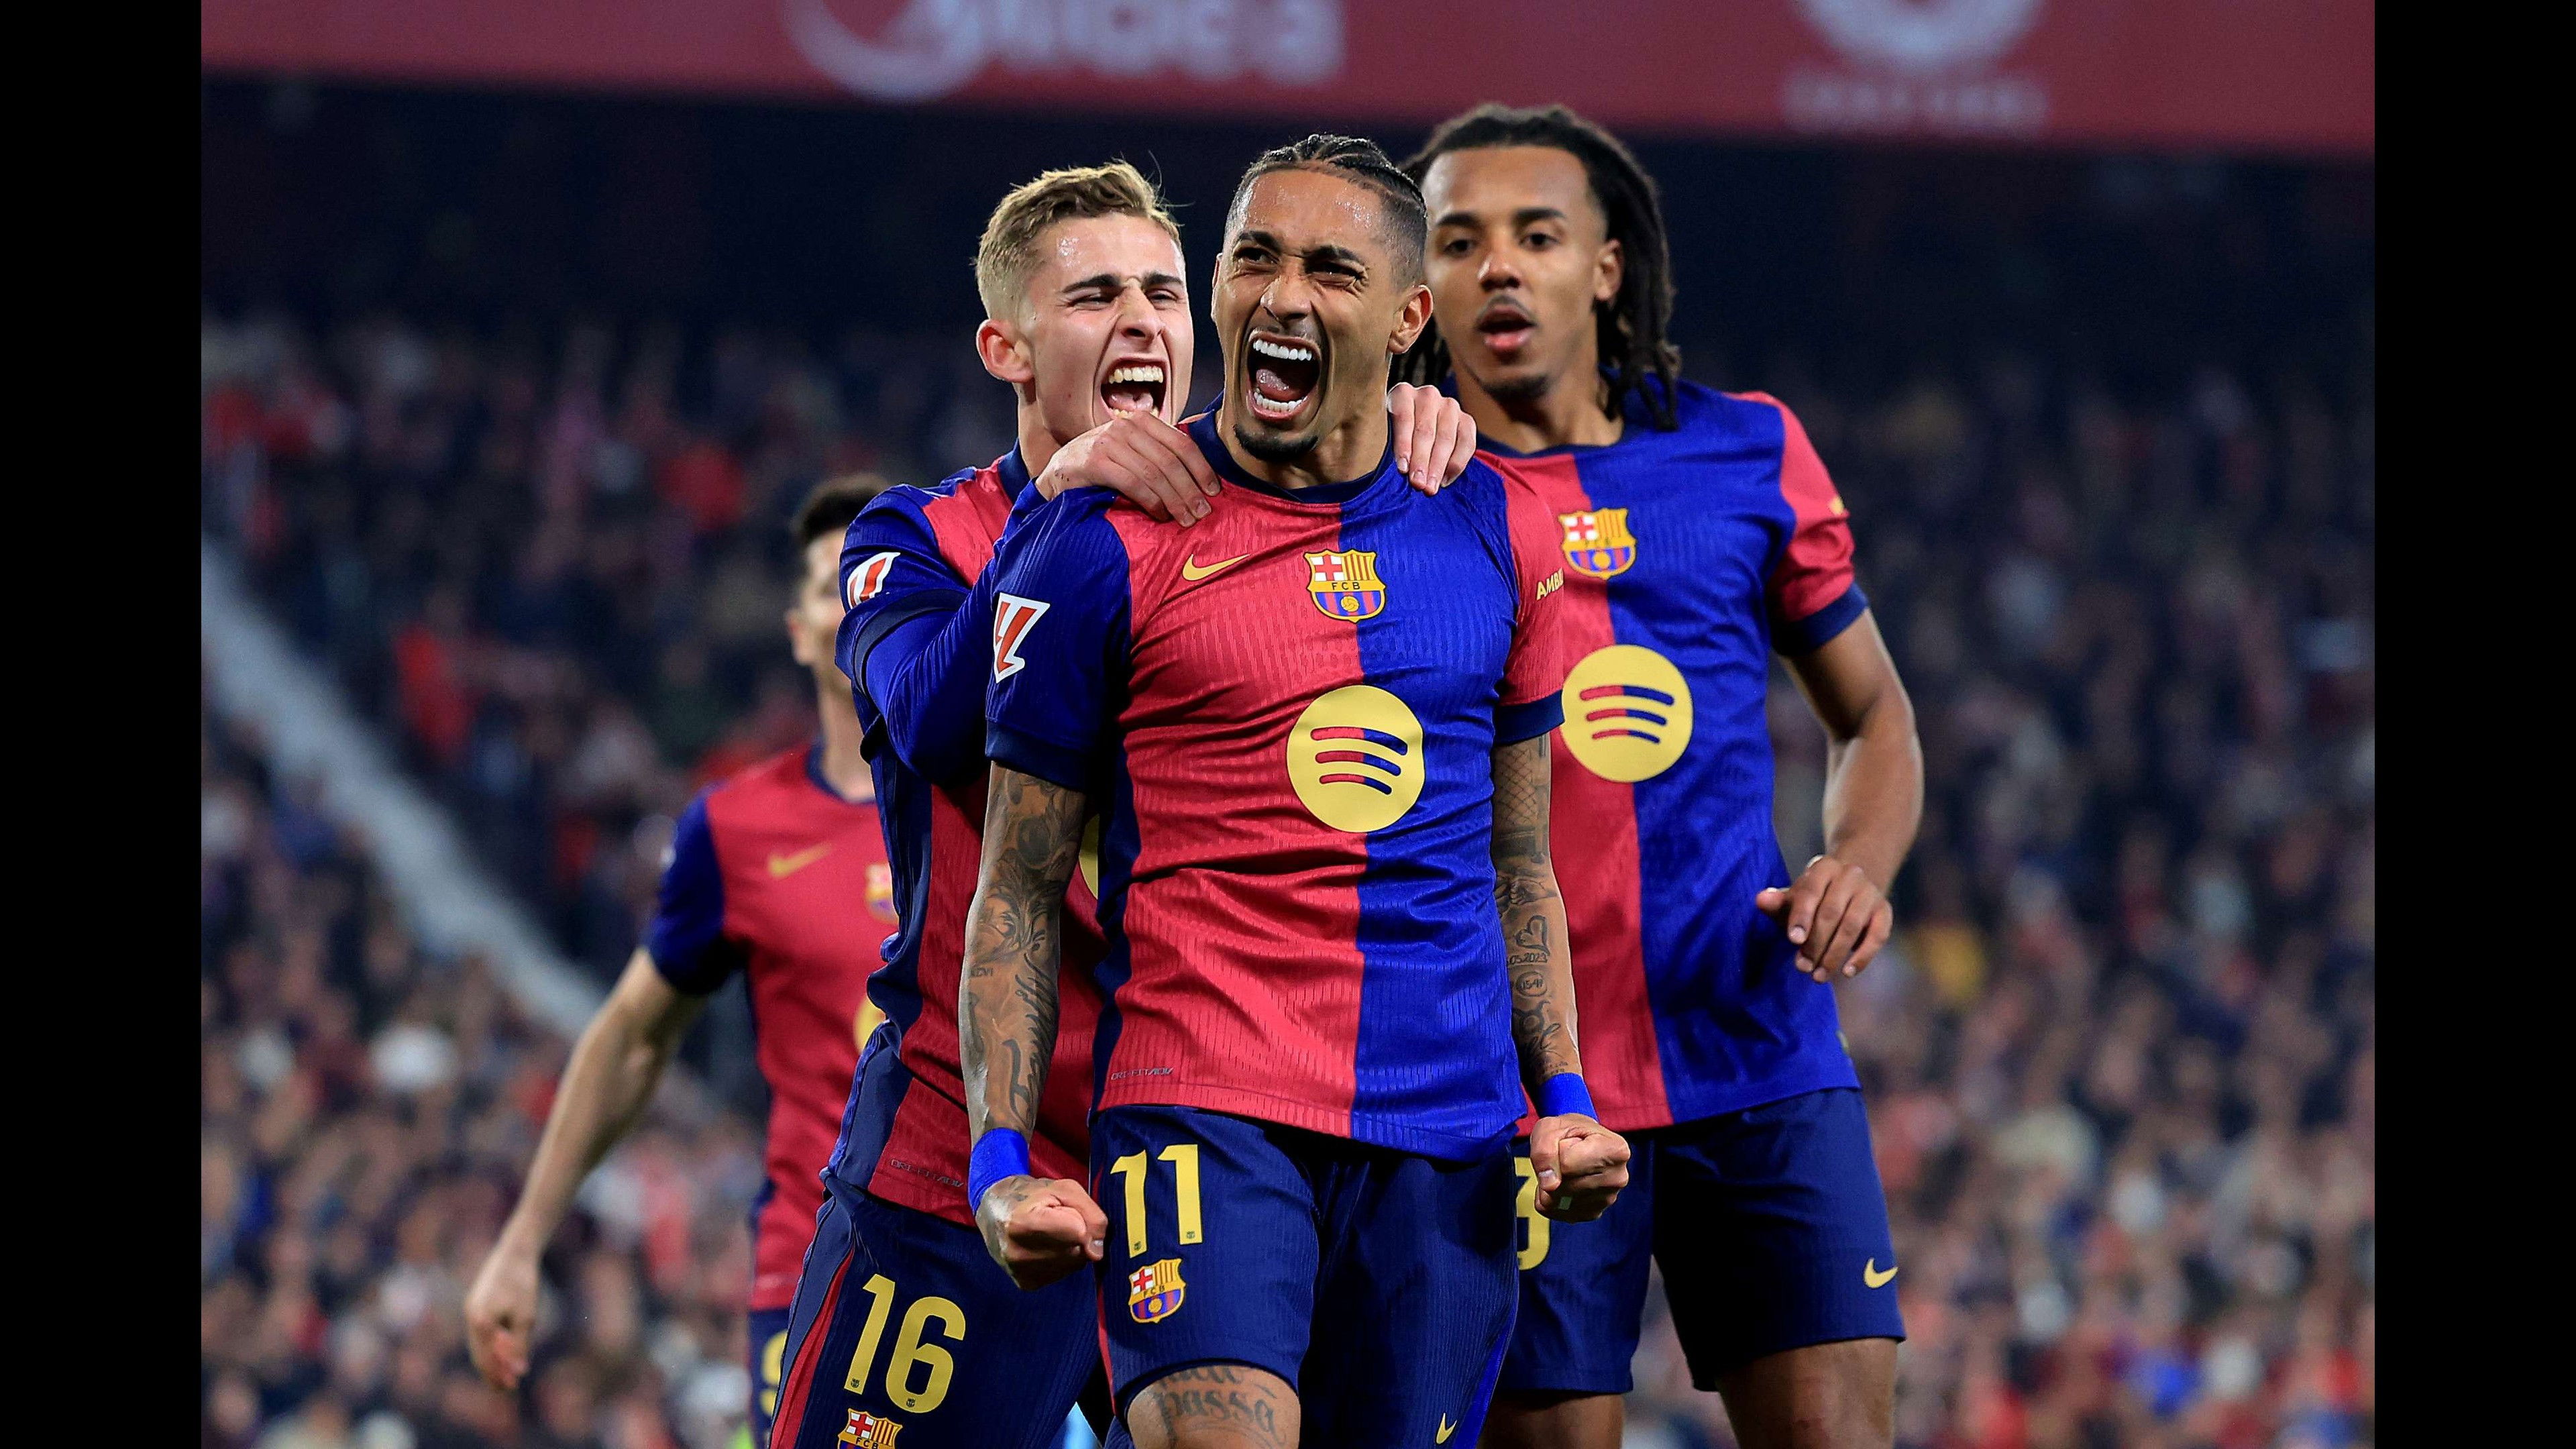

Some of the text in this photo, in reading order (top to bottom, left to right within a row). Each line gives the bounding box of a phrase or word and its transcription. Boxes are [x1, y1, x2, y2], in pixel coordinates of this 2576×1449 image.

[1331, 581, 1360, 591] FCB
[1110, 1144, 1203, 1258] 11
[1143, 1284, 1165, 1298] FCB
[844, 1273, 966, 1413] 16
[855, 1437, 879, 1449] FCB
